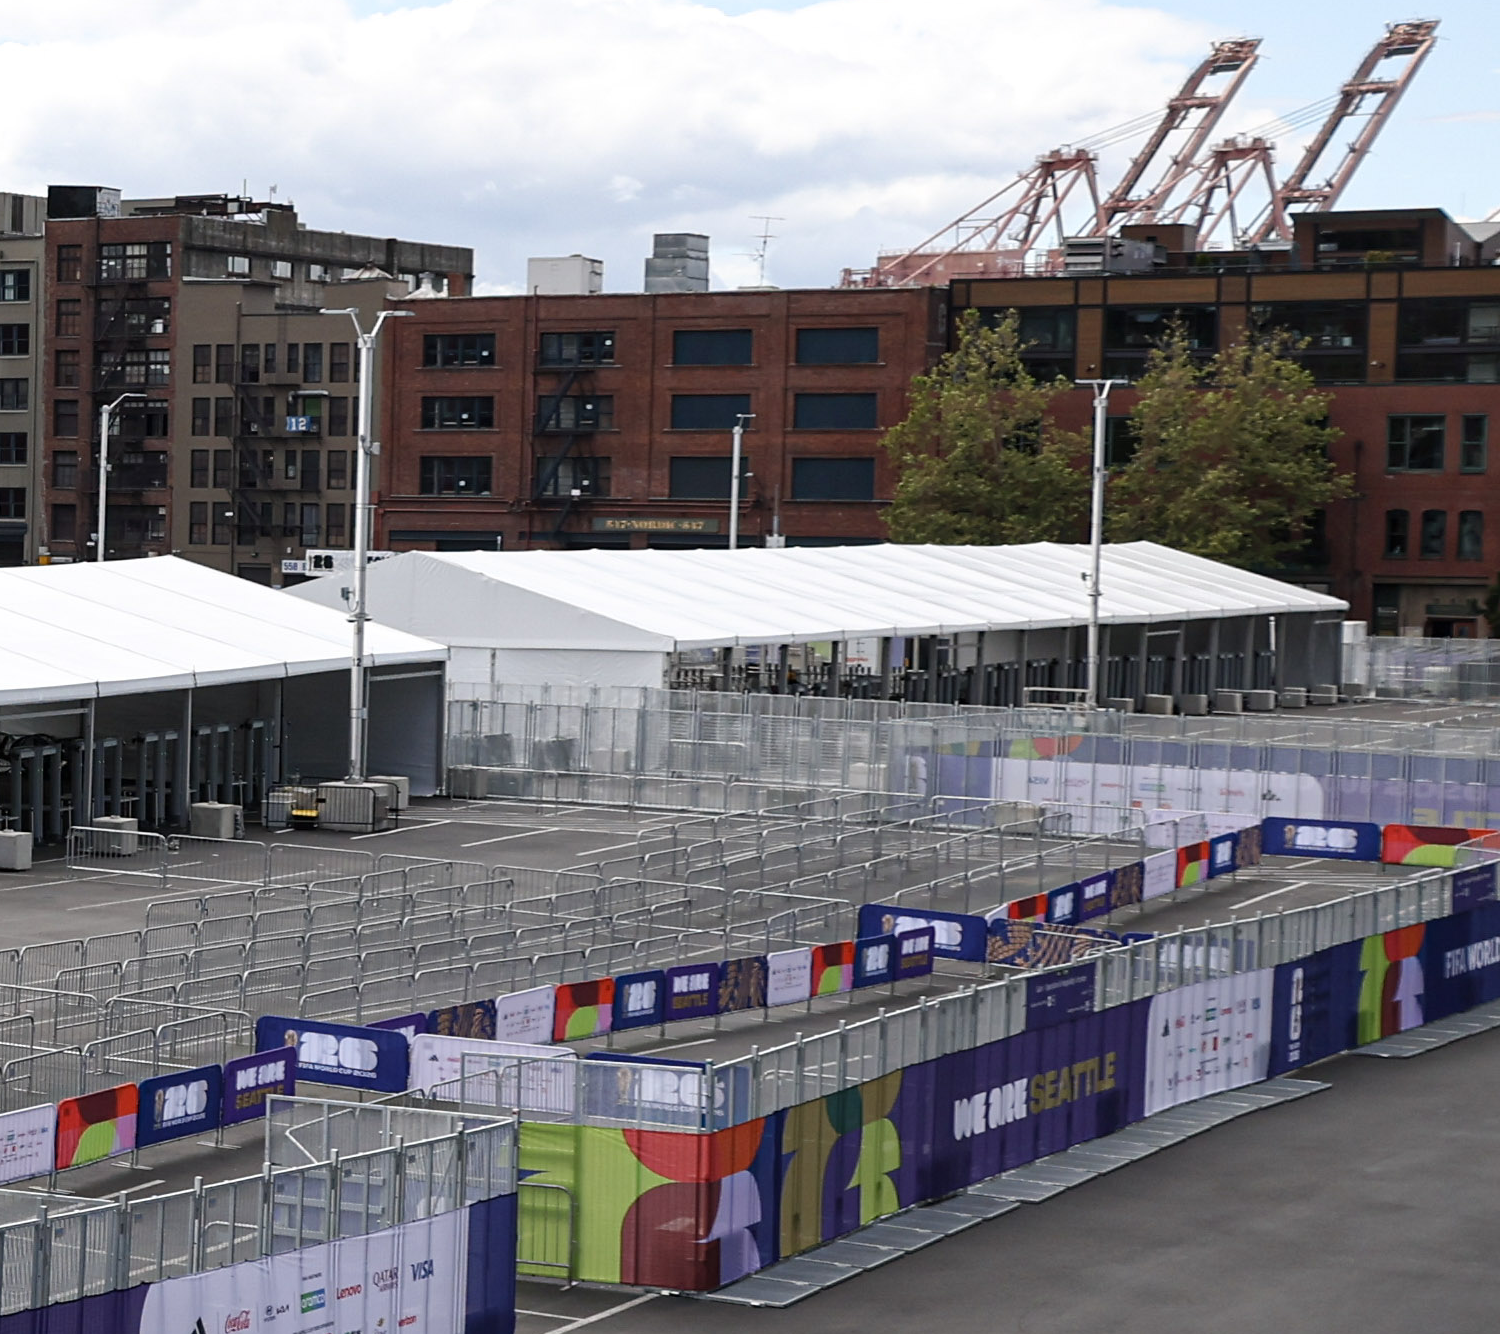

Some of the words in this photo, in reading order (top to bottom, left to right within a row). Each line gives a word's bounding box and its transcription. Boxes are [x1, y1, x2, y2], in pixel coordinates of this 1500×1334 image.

[1444, 946, 1467, 979] FIFA
[299, 1031, 379, 1071] 26
[236, 1066, 257, 1091] WE
[258, 1060, 286, 1085] ARE
[163, 1079, 209, 1121] 26
[954, 1091, 988, 1142] WE
[988, 1077, 1029, 1130] ARE
[1030, 1051, 1117, 1114] SEATTLE
[373, 1267, 398, 1287] QATAR
[411, 1259, 434, 1281] VISA
[225, 1310, 251, 1334] Coca-Cola
[336, 1284, 362, 1299] Lenovo
